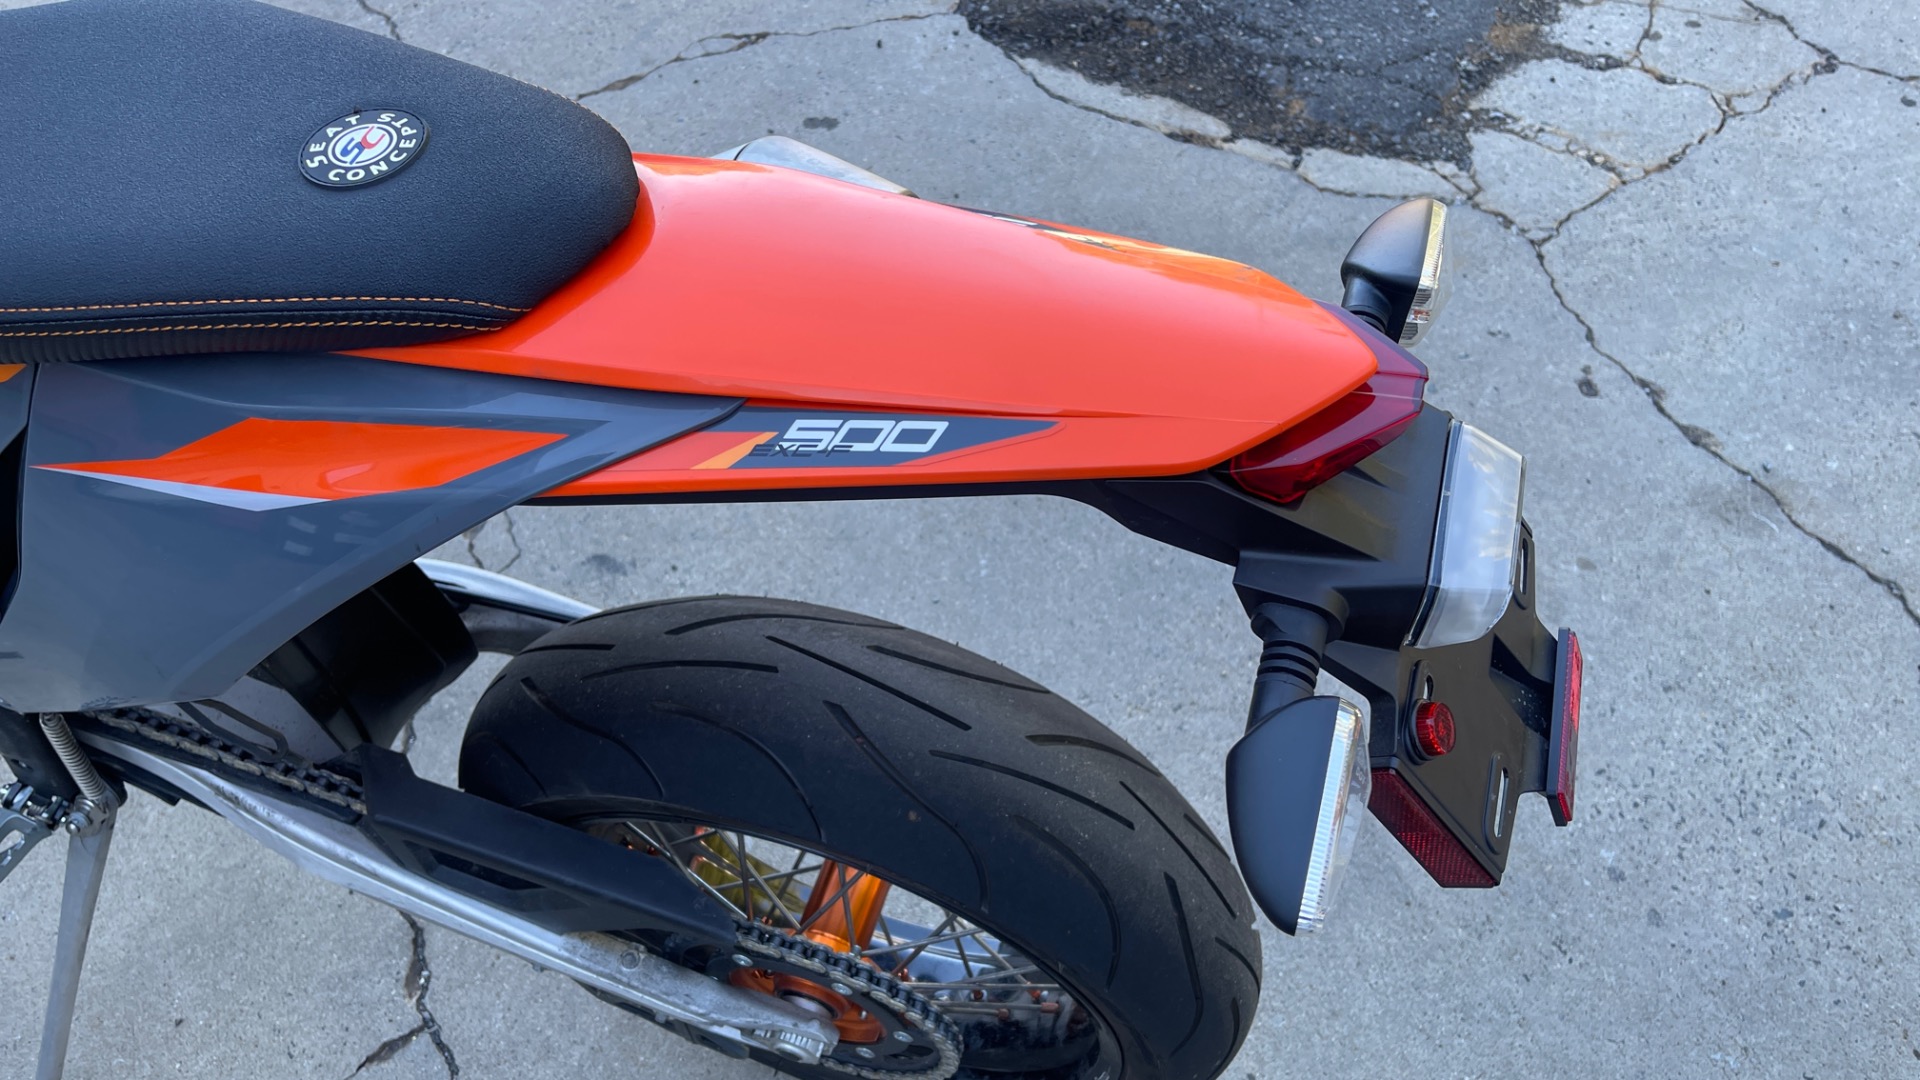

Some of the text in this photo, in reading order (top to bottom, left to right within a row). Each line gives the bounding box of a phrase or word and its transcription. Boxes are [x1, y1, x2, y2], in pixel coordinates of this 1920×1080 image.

[306, 113, 417, 181] SEAT CONCEPTS
[776, 419, 949, 453] 500
